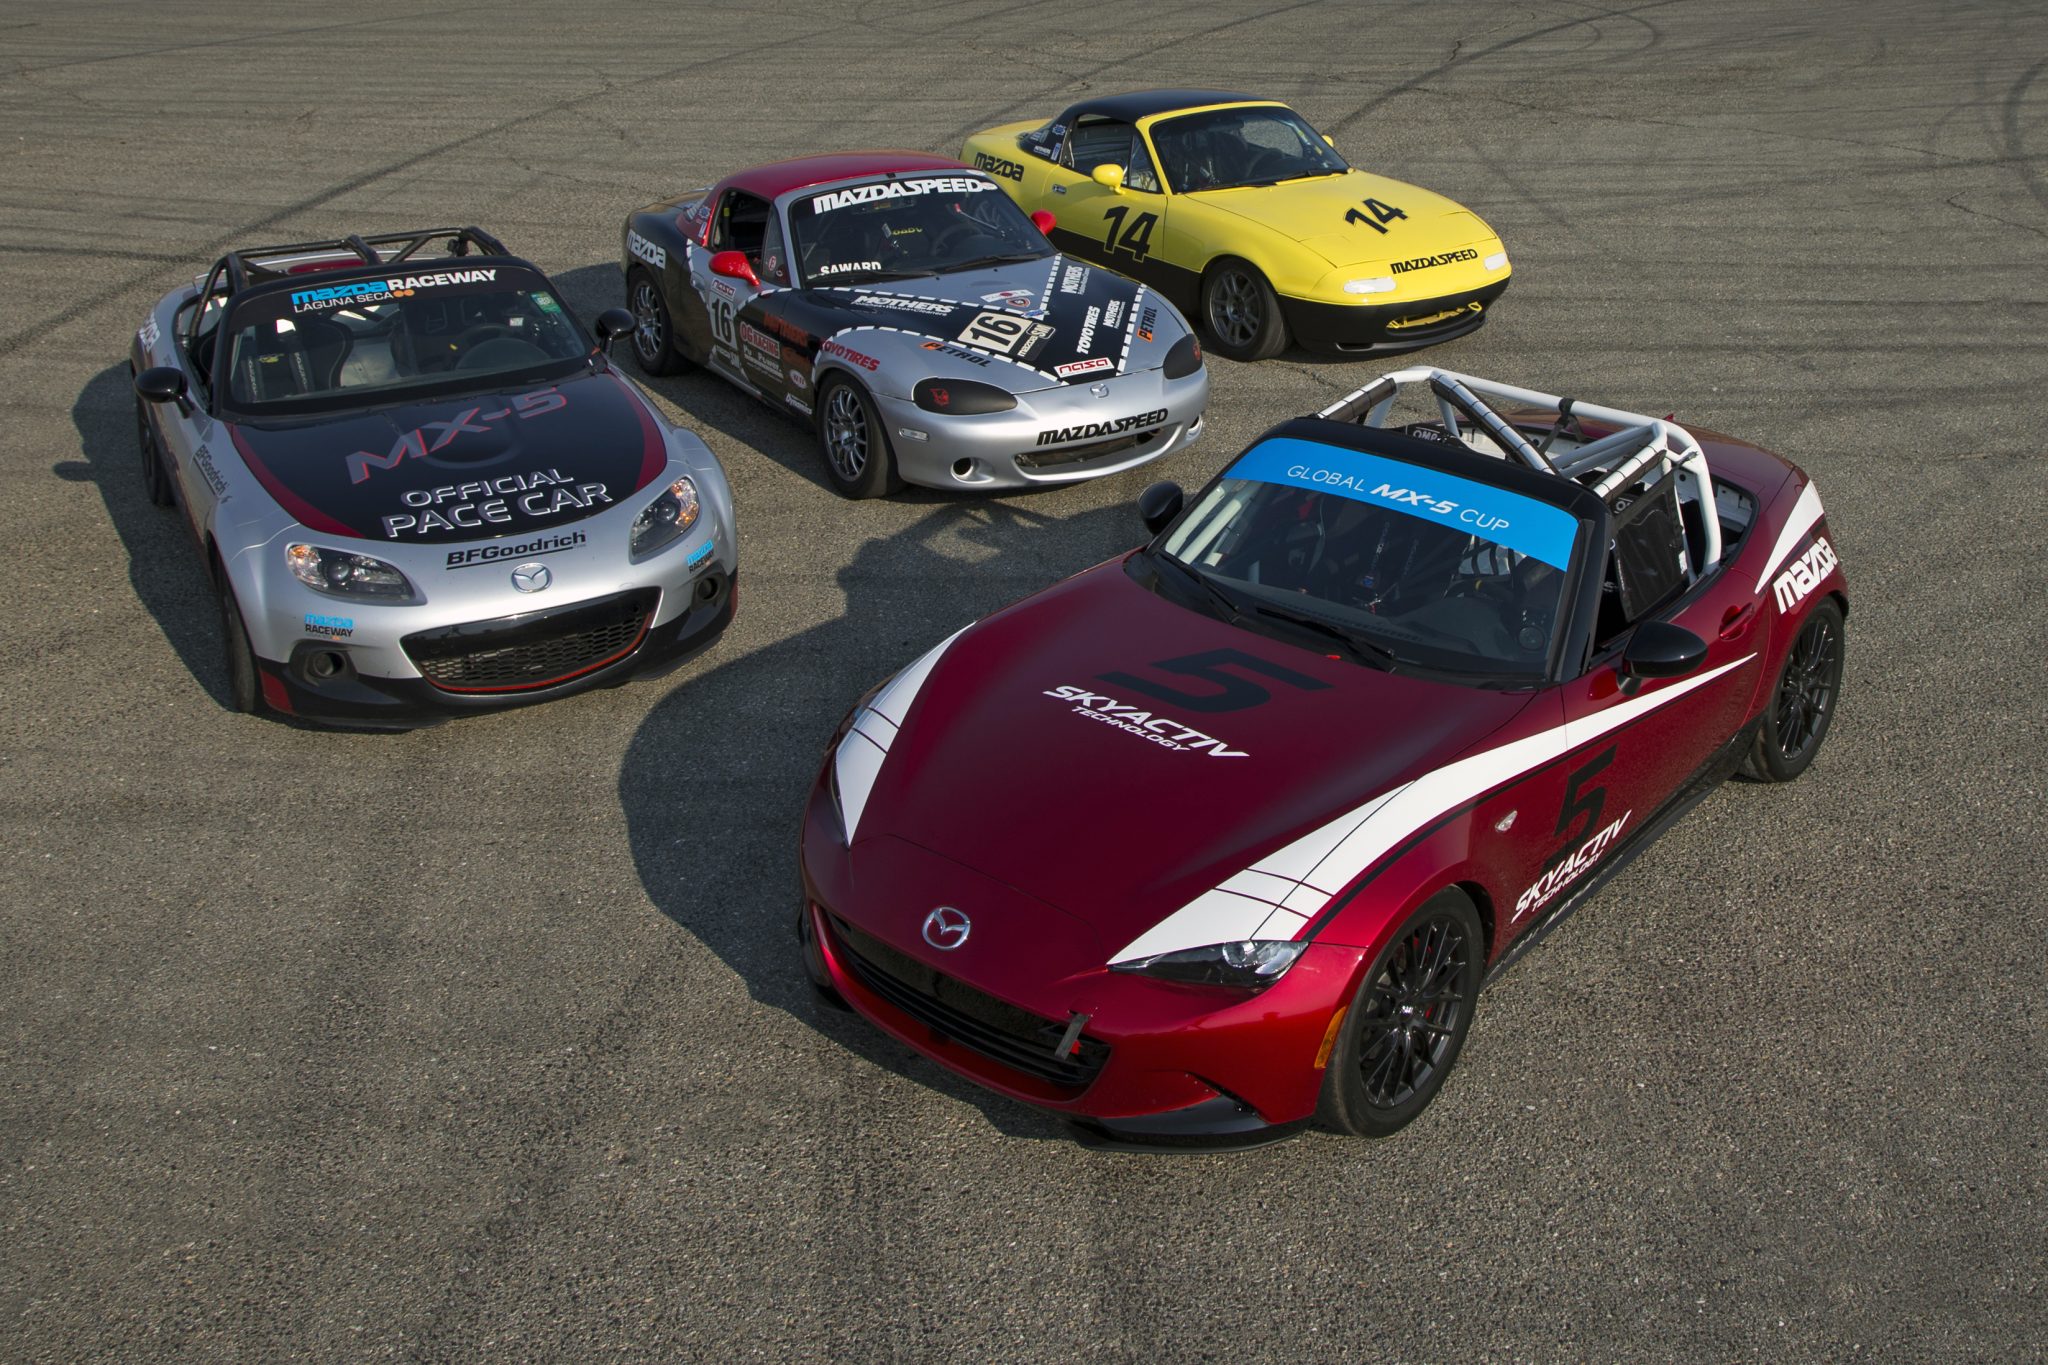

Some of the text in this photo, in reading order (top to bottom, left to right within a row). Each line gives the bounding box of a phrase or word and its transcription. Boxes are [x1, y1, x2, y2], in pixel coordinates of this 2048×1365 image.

[813, 178, 984, 214] MAZDASPEED
[1103, 205, 1159, 263] 14
[1344, 198, 1408, 234] 14
[386, 269, 497, 291] RACEWAY
[1060, 265, 1083, 294] MOTHERS
[1390, 248, 1478, 275] MAZDASPEED
[294, 291, 394, 314] LAGUNA SECA
[712, 299, 733, 343] 16
[851, 295, 955, 313] MOTHERS
[969, 316, 1023, 347] 16
[1030, 323, 1051, 338] SM
[1137, 306, 1157, 342] PETROL
[923, 341, 992, 368] PETROL
[345, 386, 567, 484] MX-5
[1036, 407, 1168, 446] MAZDASPEED
[195, 443, 229, 497] BFGoodrich
[400, 468, 574, 507] OFFICIAL
[381, 482, 613, 538] PACE CAR
[1287, 464, 1510, 532] GLOBAL MX-5 CUP
[446, 531, 586, 566] BFGoodrich
[1773, 536, 1838, 614] mazda
[304, 623, 354, 637] RACEWAY
[1093, 647, 1336, 713] 5
[1042, 685, 1250, 758] SKYACTIV
[1071, 705, 1191, 751] TECHNOLOGY
[1539, 742, 1618, 880] 5
[1510, 808, 1632, 924] SKYACTIV
[1532, 849, 1604, 912] TECHNOLOGY
